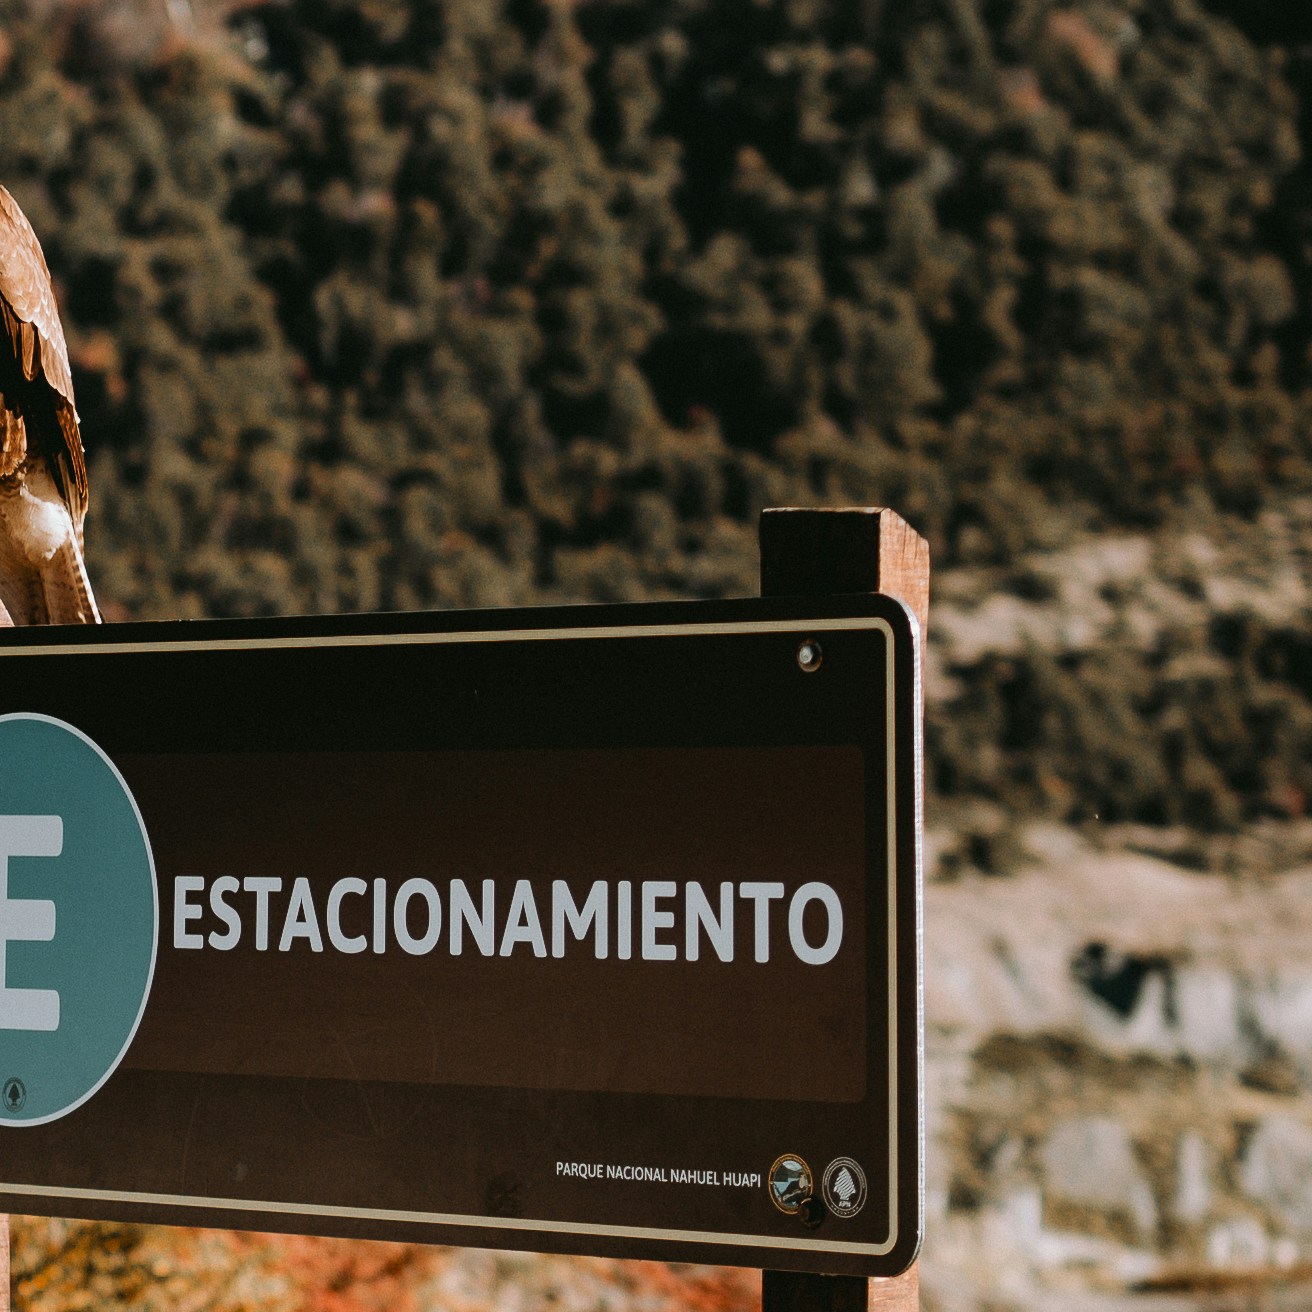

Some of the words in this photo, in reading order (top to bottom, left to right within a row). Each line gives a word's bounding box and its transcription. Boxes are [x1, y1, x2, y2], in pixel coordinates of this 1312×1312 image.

[173, 875, 844, 966] ESTACIONAMIENTO
[556, 1161, 604, 1180] PARQUE
[606, 1164, 668, 1183] NACIONAL
[670, 1168, 721, 1186] NAHUEL
[723, 1171, 761, 1188] HUAPI
